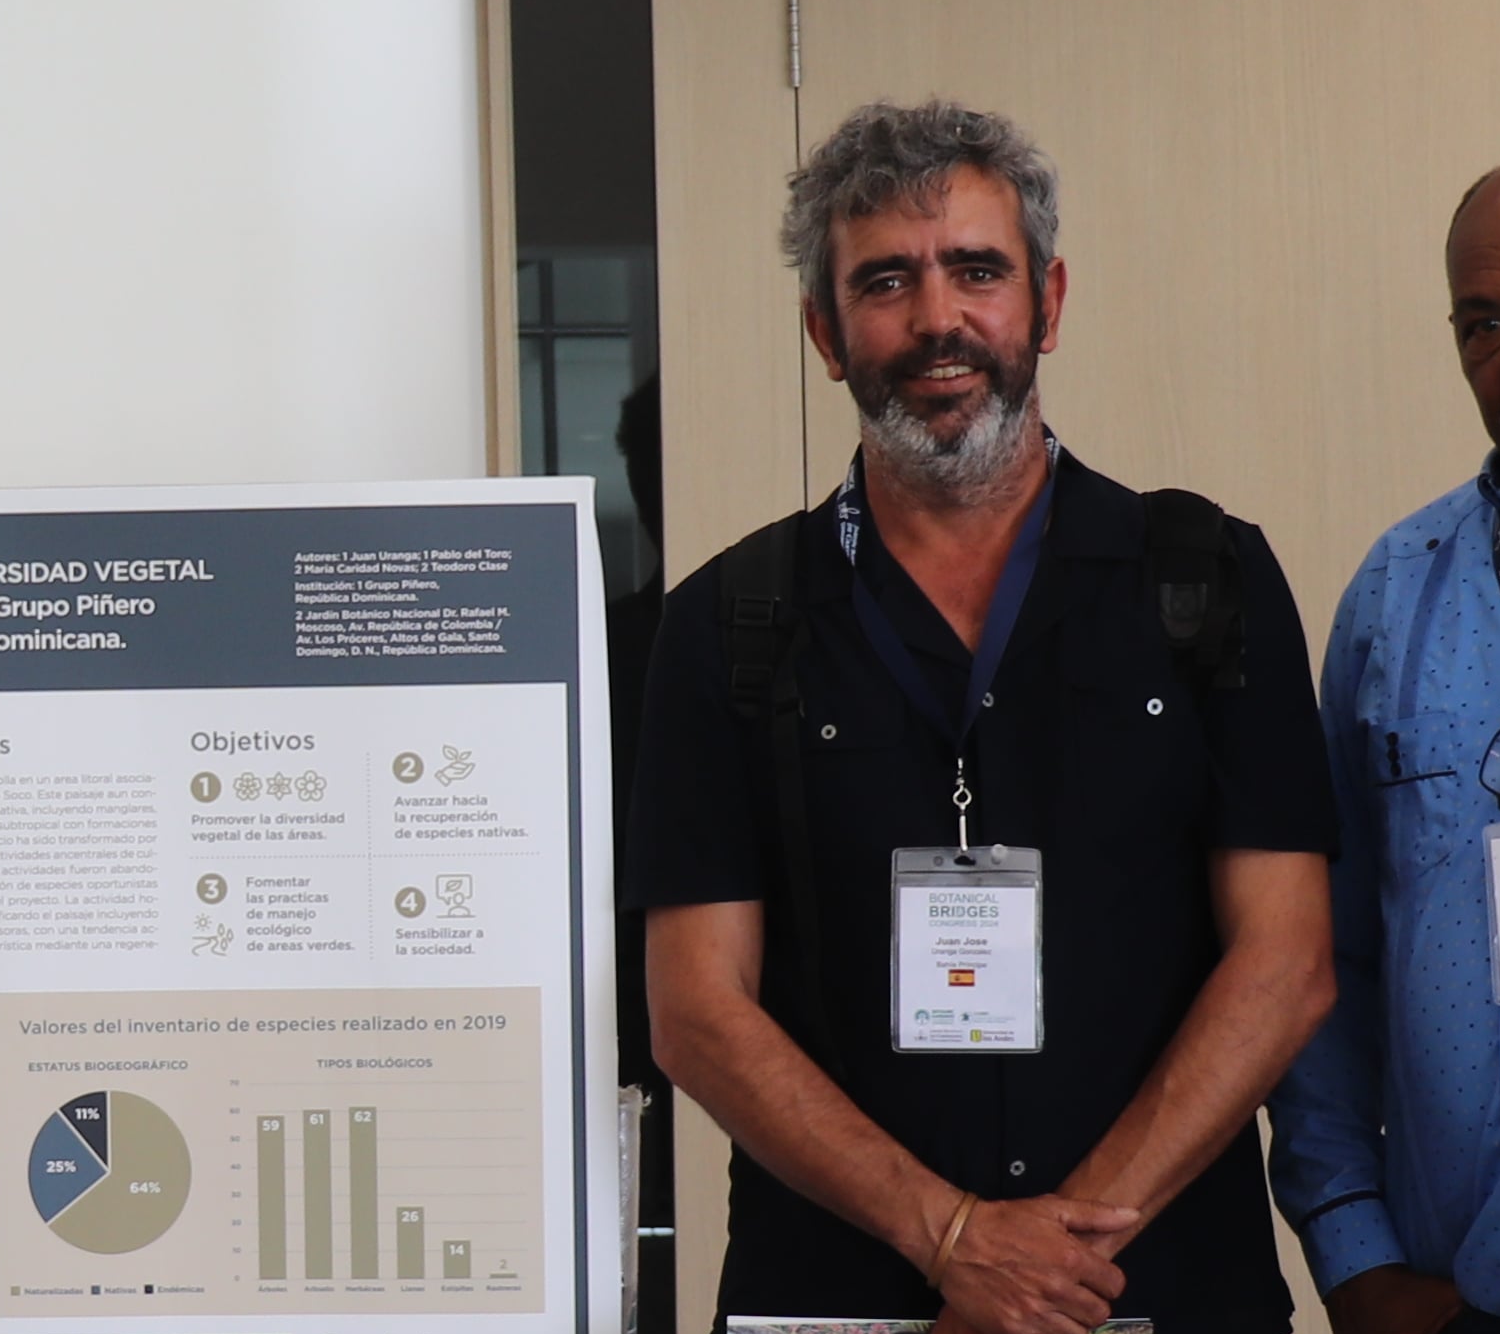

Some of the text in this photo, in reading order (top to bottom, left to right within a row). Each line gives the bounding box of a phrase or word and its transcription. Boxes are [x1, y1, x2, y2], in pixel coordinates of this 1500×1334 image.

[293, 548, 512, 562] Autores: 1 Juan Uranga; 1 Pablo del Toro;
[92, 559, 214, 582] VEGETAL
[293, 560, 508, 575] 2 Maria Caridad Novas; 2 Teodoro Clase
[294, 579, 441, 592] Institución: 1 Grupo Piñero,
[76, 593, 155, 616] Piñero
[294, 591, 419, 605] República Dominicana.
[294, 606, 511, 621] 2 Jardin Botánico Nacional Dr. Rafael M.
[294, 618, 503, 633] Moscoso, Av. República de Colombia /
[190, 729, 315, 755] Objetivos
[401, 758, 416, 777] 2
[200, 777, 210, 797] 1
[393, 794, 488, 807] Avanzar hacia
[190, 811, 345, 825] Promover la diversidad
[393, 809, 498, 824] la recuperación
[190, 827, 327, 843] vegetal de las áreas.
[393, 825, 529, 841] de especies nativas.
[245, 875, 311, 888] Fomentar
[205, 879, 219, 899] 3
[245, 891, 329, 905] las practicas
[401, 892, 418, 912] 4
[929, 893, 999, 904] BOTANICAL
[245, 907, 317, 923] de manejo
[929, 906, 999, 919] BRIDGES
[245, 923, 312, 938] ecológico
[394, 927, 484, 940] Sensibilizar a
[245, 938, 355, 952] de areas verdes.
[394, 942, 476, 955] la sociedad.
[935, 937, 961, 946] Juan
[18, 1014, 506, 1035] Valores del inventario de especies realizado en 2019
[27, 1058, 189, 1072] ESTATUS BIOGEOGRÁFICO
[315, 1055, 433, 1069] TIPOS BIOLÓGICOS
[74, 1107, 100, 1121] 11%
[309, 1113, 325, 1126] 61
[354, 1111, 372, 1123] 62
[262, 1120, 280, 1132] 59
[46, 1160, 76, 1174] 25%
[129, 1181, 161, 1195] 64%
[401, 1210, 419, 1223] 26
[449, 1244, 465, 1256] 14
